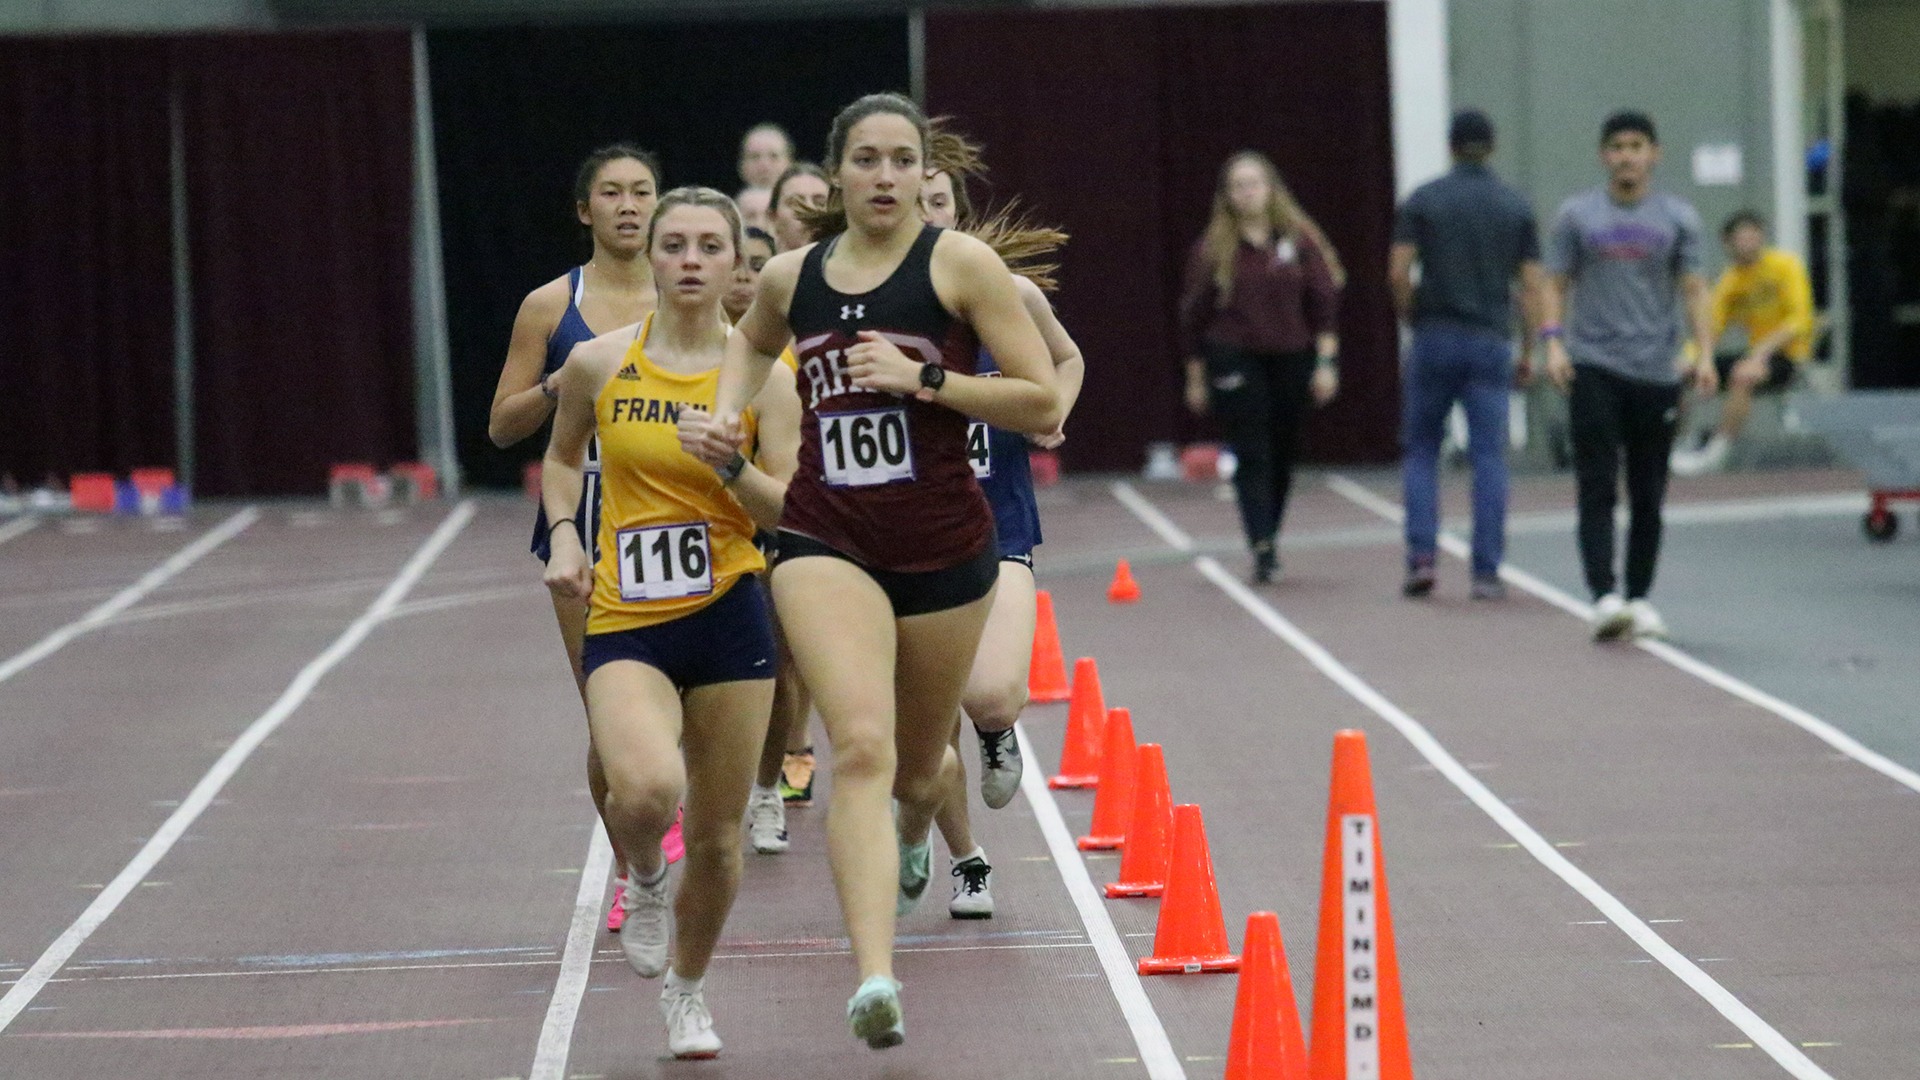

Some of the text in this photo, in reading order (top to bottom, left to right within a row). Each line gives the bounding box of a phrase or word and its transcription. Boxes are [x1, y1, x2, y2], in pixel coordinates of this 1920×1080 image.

[612, 398, 707, 425] FRAN
[825, 413, 906, 471] 160
[624, 528, 707, 584] 116
